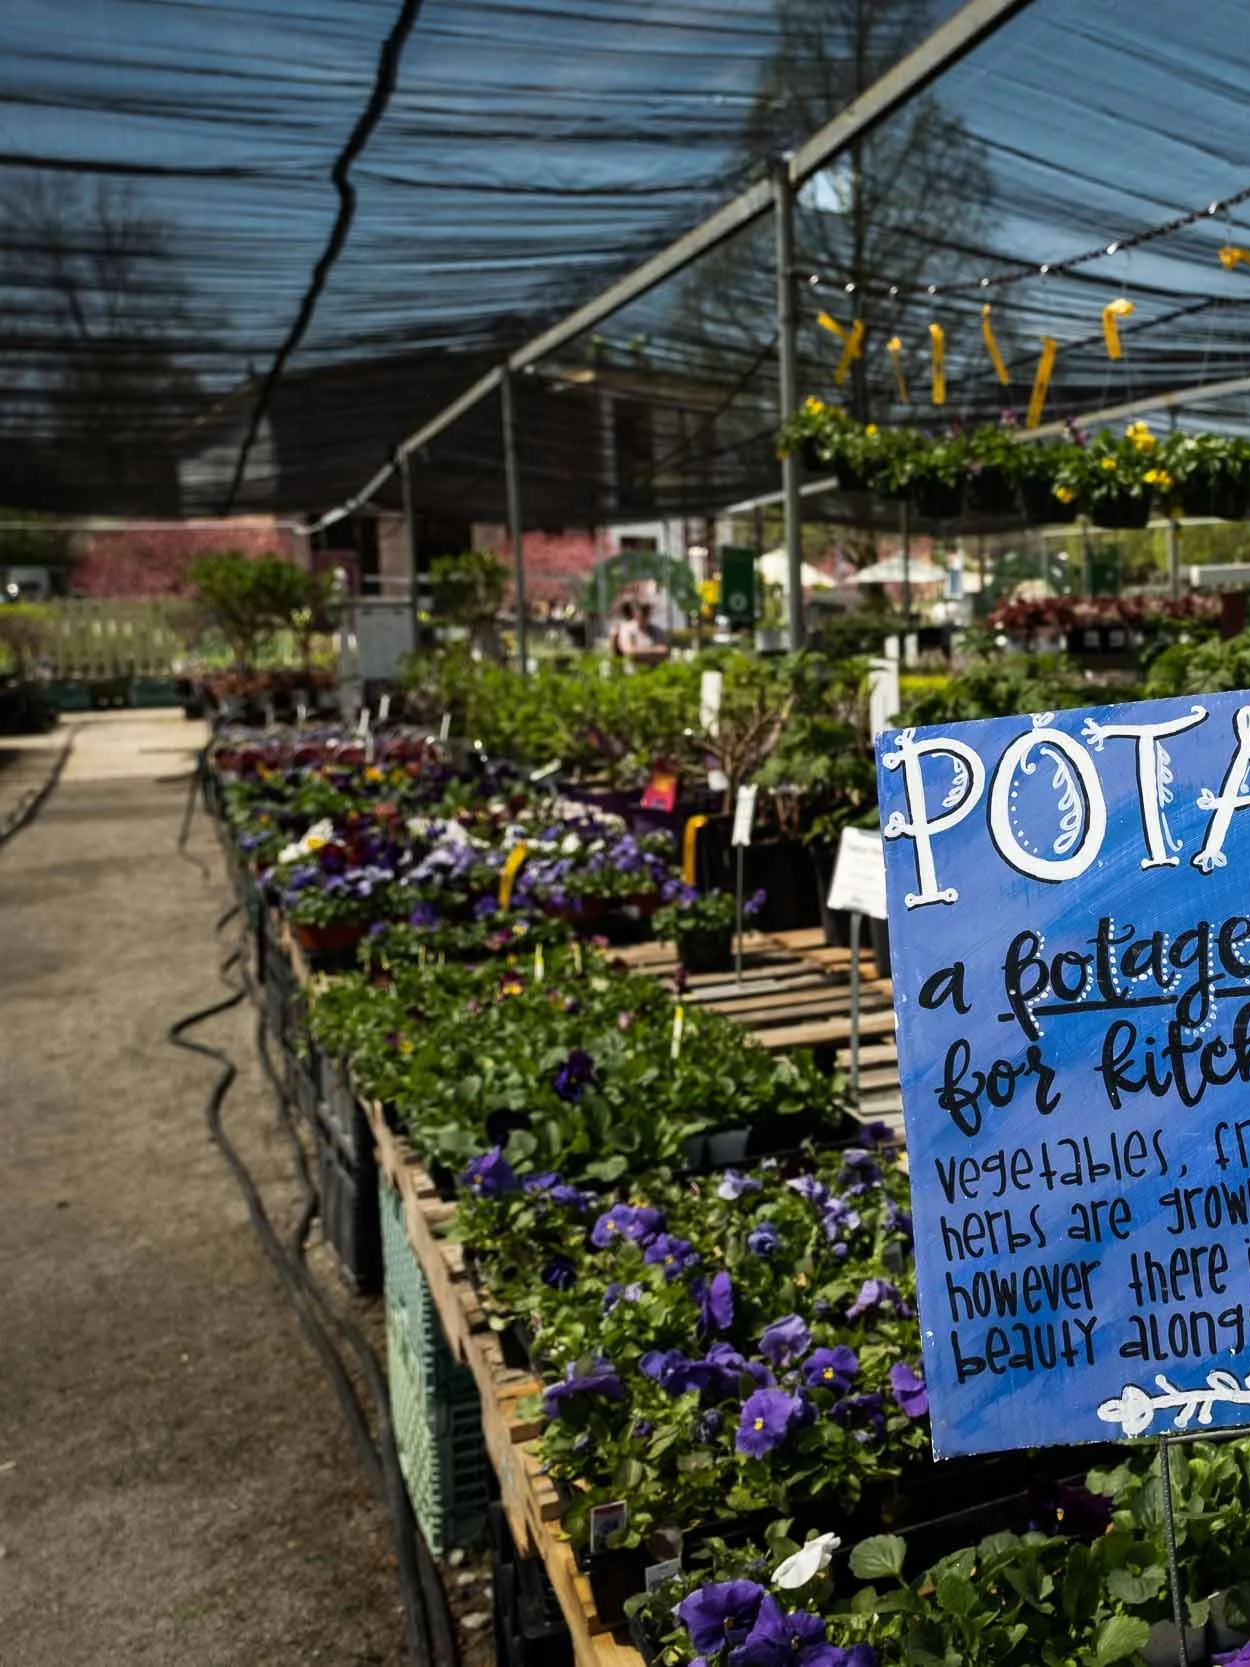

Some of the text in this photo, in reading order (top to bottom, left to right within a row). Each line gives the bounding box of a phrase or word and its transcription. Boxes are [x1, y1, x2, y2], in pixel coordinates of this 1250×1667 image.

[918, 962, 971, 1014] a
[934, 1039, 1061, 1137] for
[935, 1129, 1187, 1204] vegetables,
[940, 1204, 1046, 1261] herbs
[1068, 1198, 1132, 1243] are
[945, 1260, 1100, 1322] however
[1128, 1243, 1228, 1306] there
